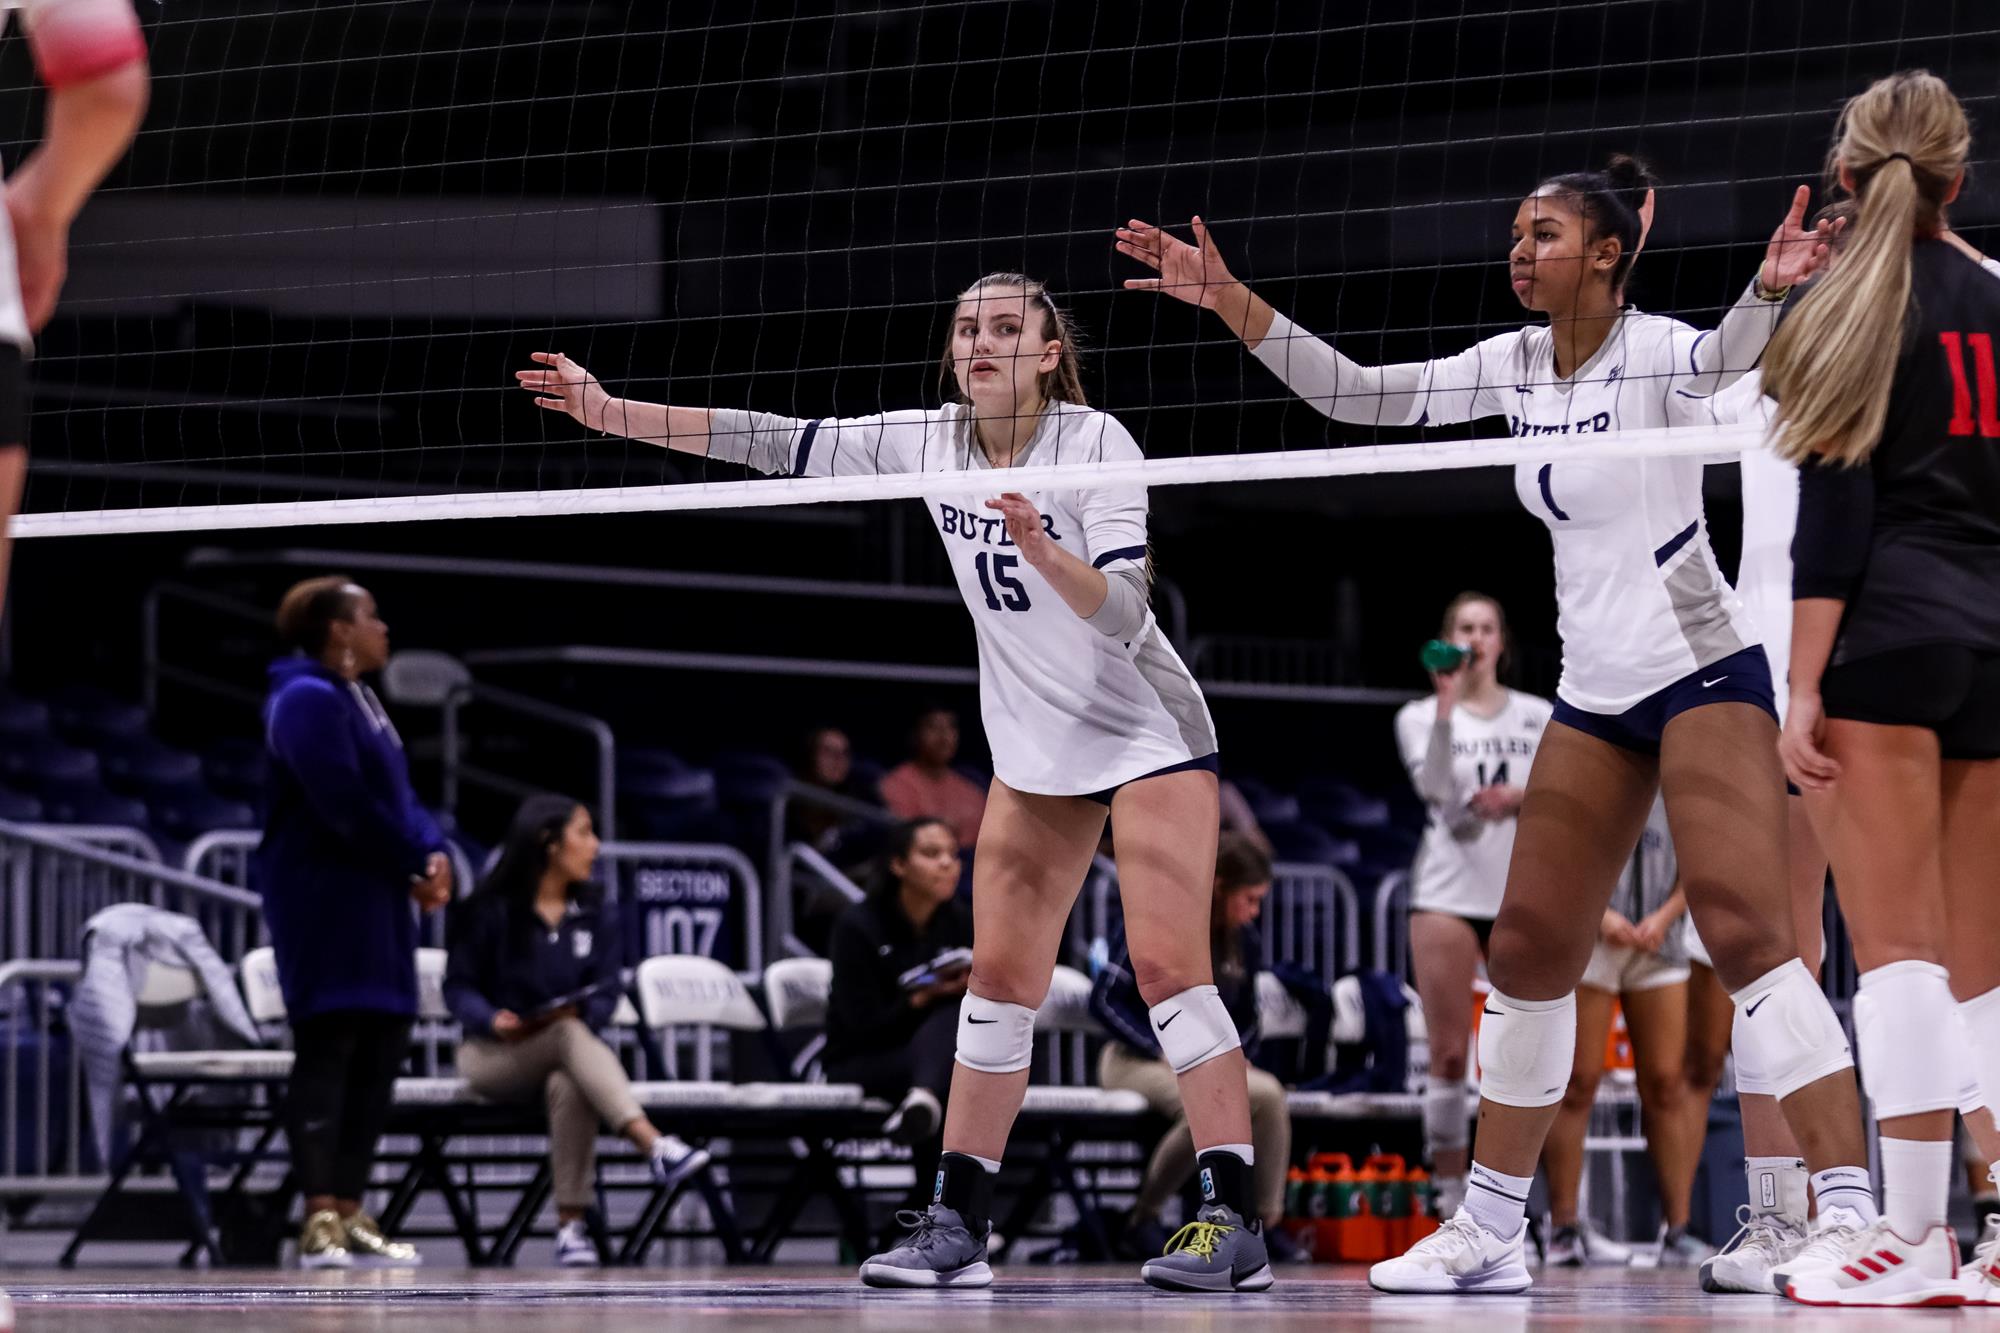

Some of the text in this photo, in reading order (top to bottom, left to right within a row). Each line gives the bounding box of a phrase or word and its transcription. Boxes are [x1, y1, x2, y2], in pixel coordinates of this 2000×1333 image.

[1939, 331, 2000, 437] 11
[939, 503, 1062, 546] BUTLR
[975, 551, 1031, 612] 15
[636, 870, 730, 901] SECTION
[646, 906, 723, 957] 107
